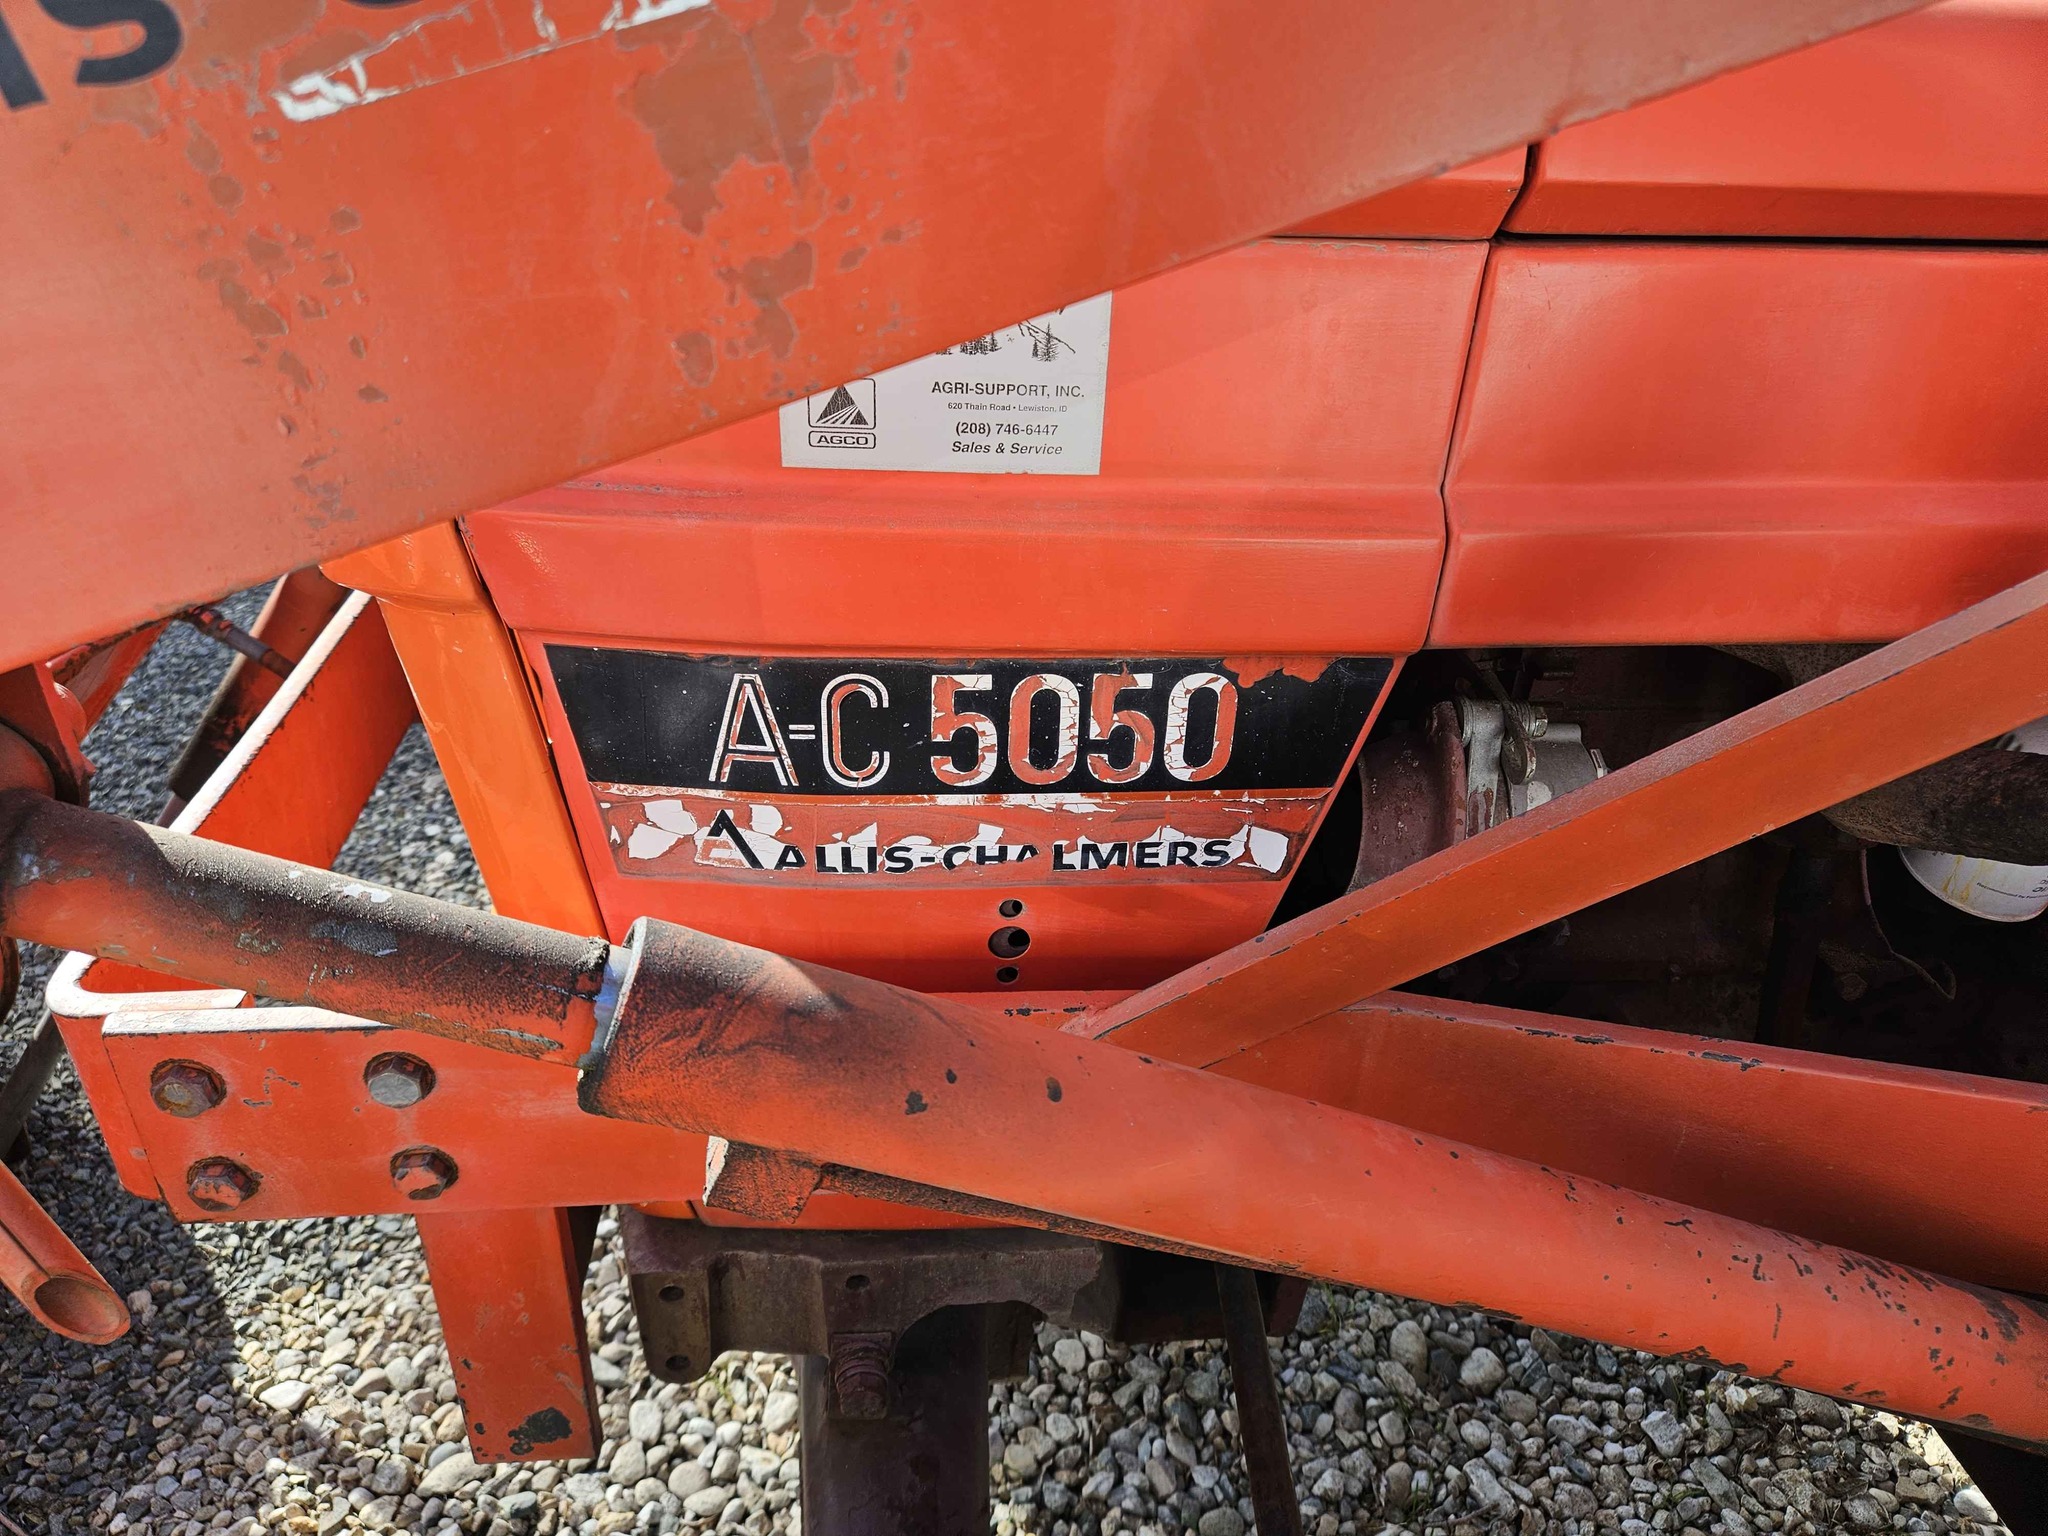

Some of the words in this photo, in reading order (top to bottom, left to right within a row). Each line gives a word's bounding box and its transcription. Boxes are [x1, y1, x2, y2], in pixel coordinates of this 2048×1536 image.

[931, 381, 1050, 398] AGRI-SUPPORT,
[1055, 385, 1085, 397] INC.
[947, 402, 963, 410] 620
[964, 402, 987, 411] Thain
[989, 403, 1011, 411] Road
[955, 421, 991, 437] (208)
[995, 424, 1059, 436] 746-6447
[817, 435, 869, 446] AGCO
[952, 441, 991, 454] Sales
[995, 442, 1006, 454] &
[1009, 442, 1063, 455] Service
[930, 672, 1239, 786] 5050
